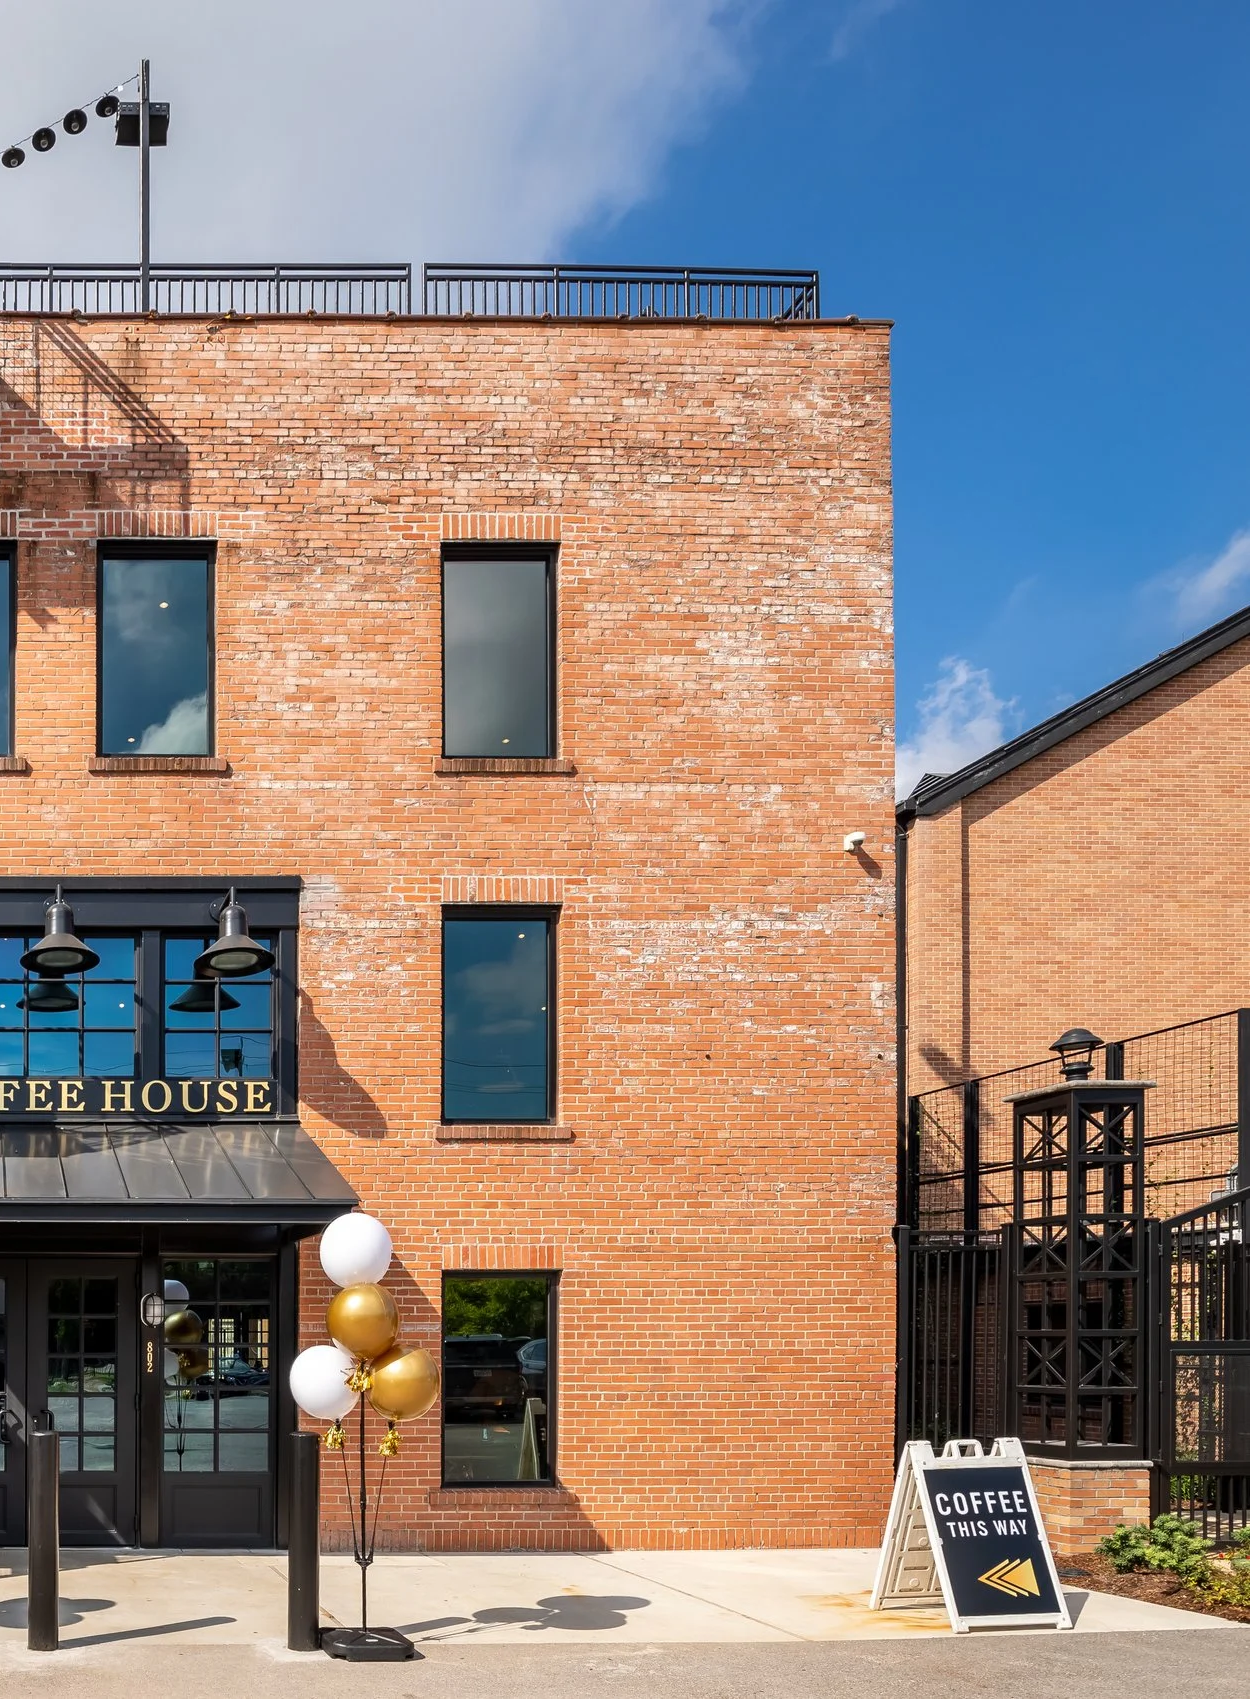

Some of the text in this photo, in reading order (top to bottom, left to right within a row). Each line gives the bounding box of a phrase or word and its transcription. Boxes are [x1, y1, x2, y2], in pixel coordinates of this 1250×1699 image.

[101, 1080, 272, 1113] HOUSE
[935, 1490, 1028, 1516] COFFEE
[946, 1519, 1029, 1538] THIS WAY
